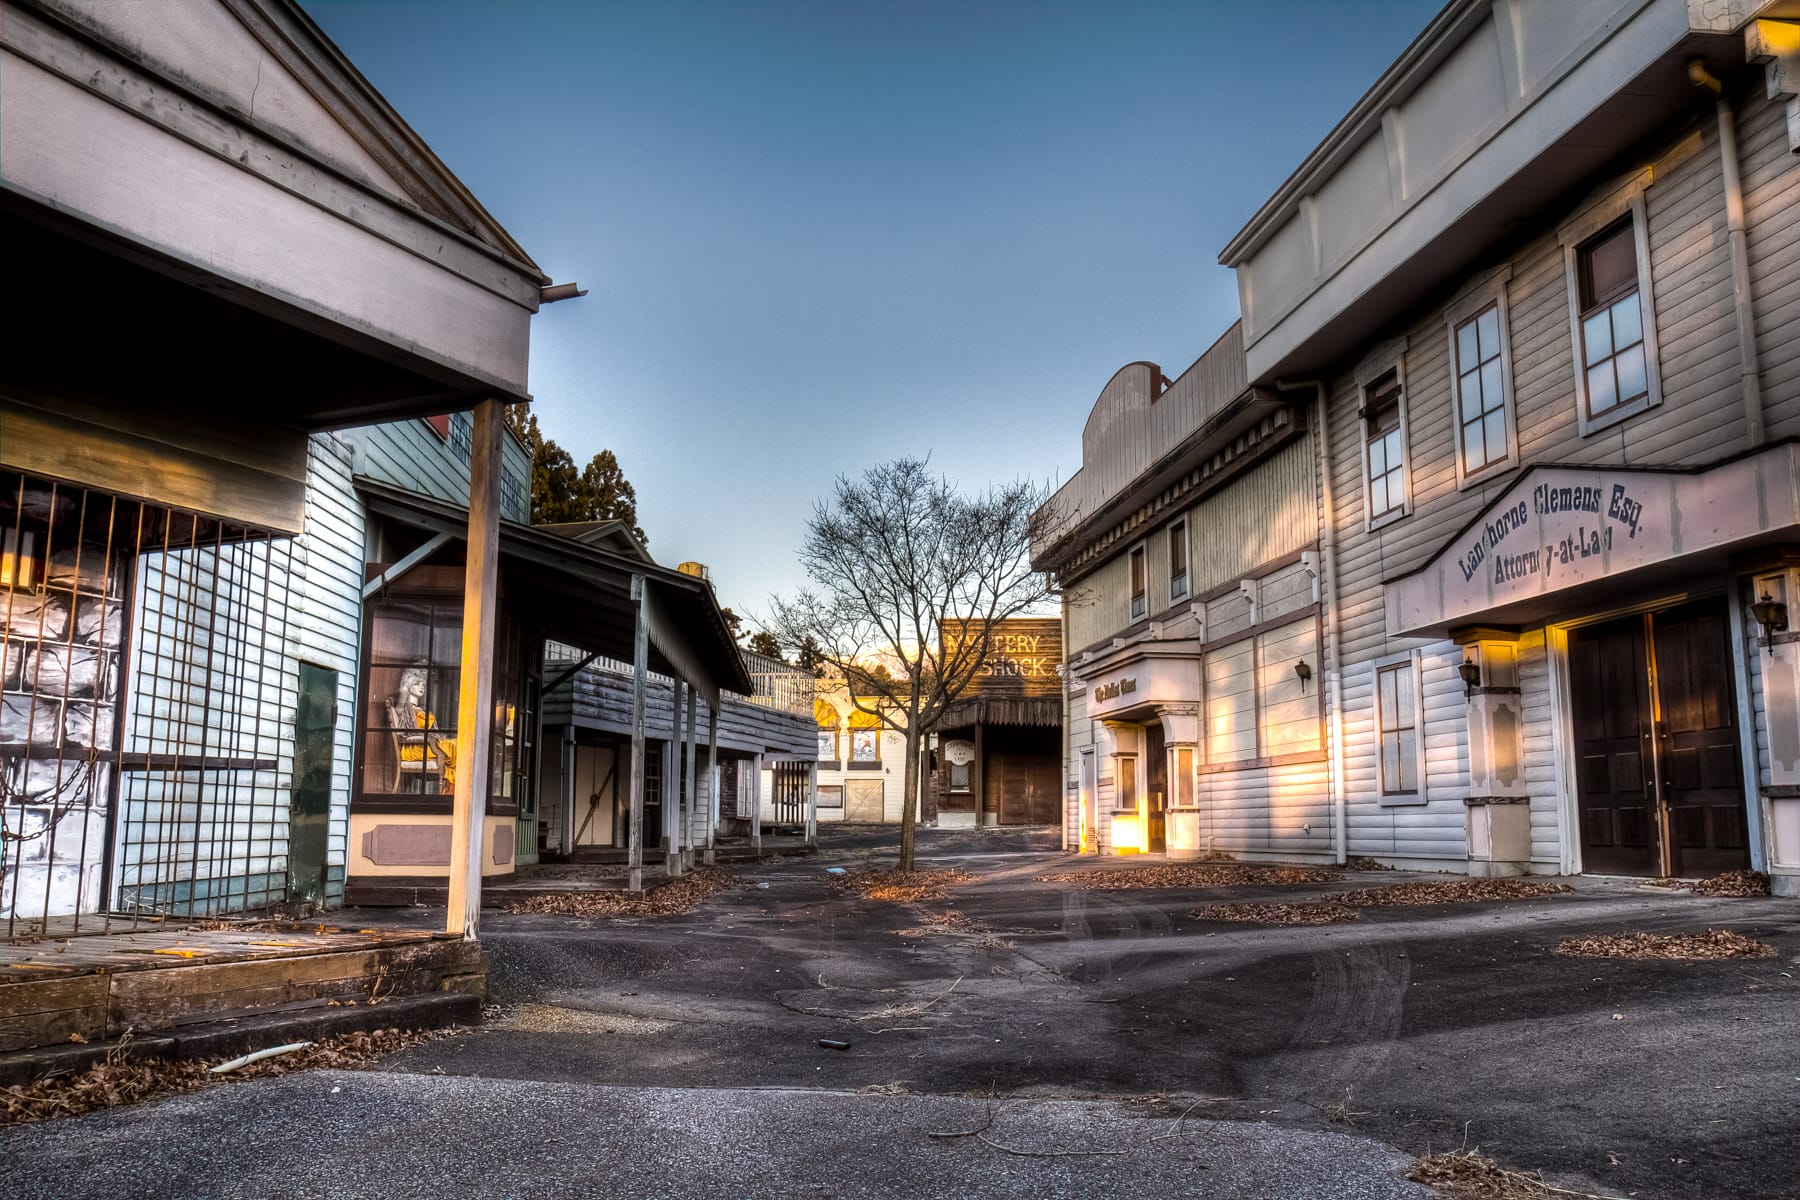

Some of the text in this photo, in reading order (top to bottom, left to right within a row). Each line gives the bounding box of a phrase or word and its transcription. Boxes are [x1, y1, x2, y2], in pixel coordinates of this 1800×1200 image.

[1458, 483, 1643, 583] Lanhorne Clemens Esq.
[947, 635, 1040, 653] MYTERY
